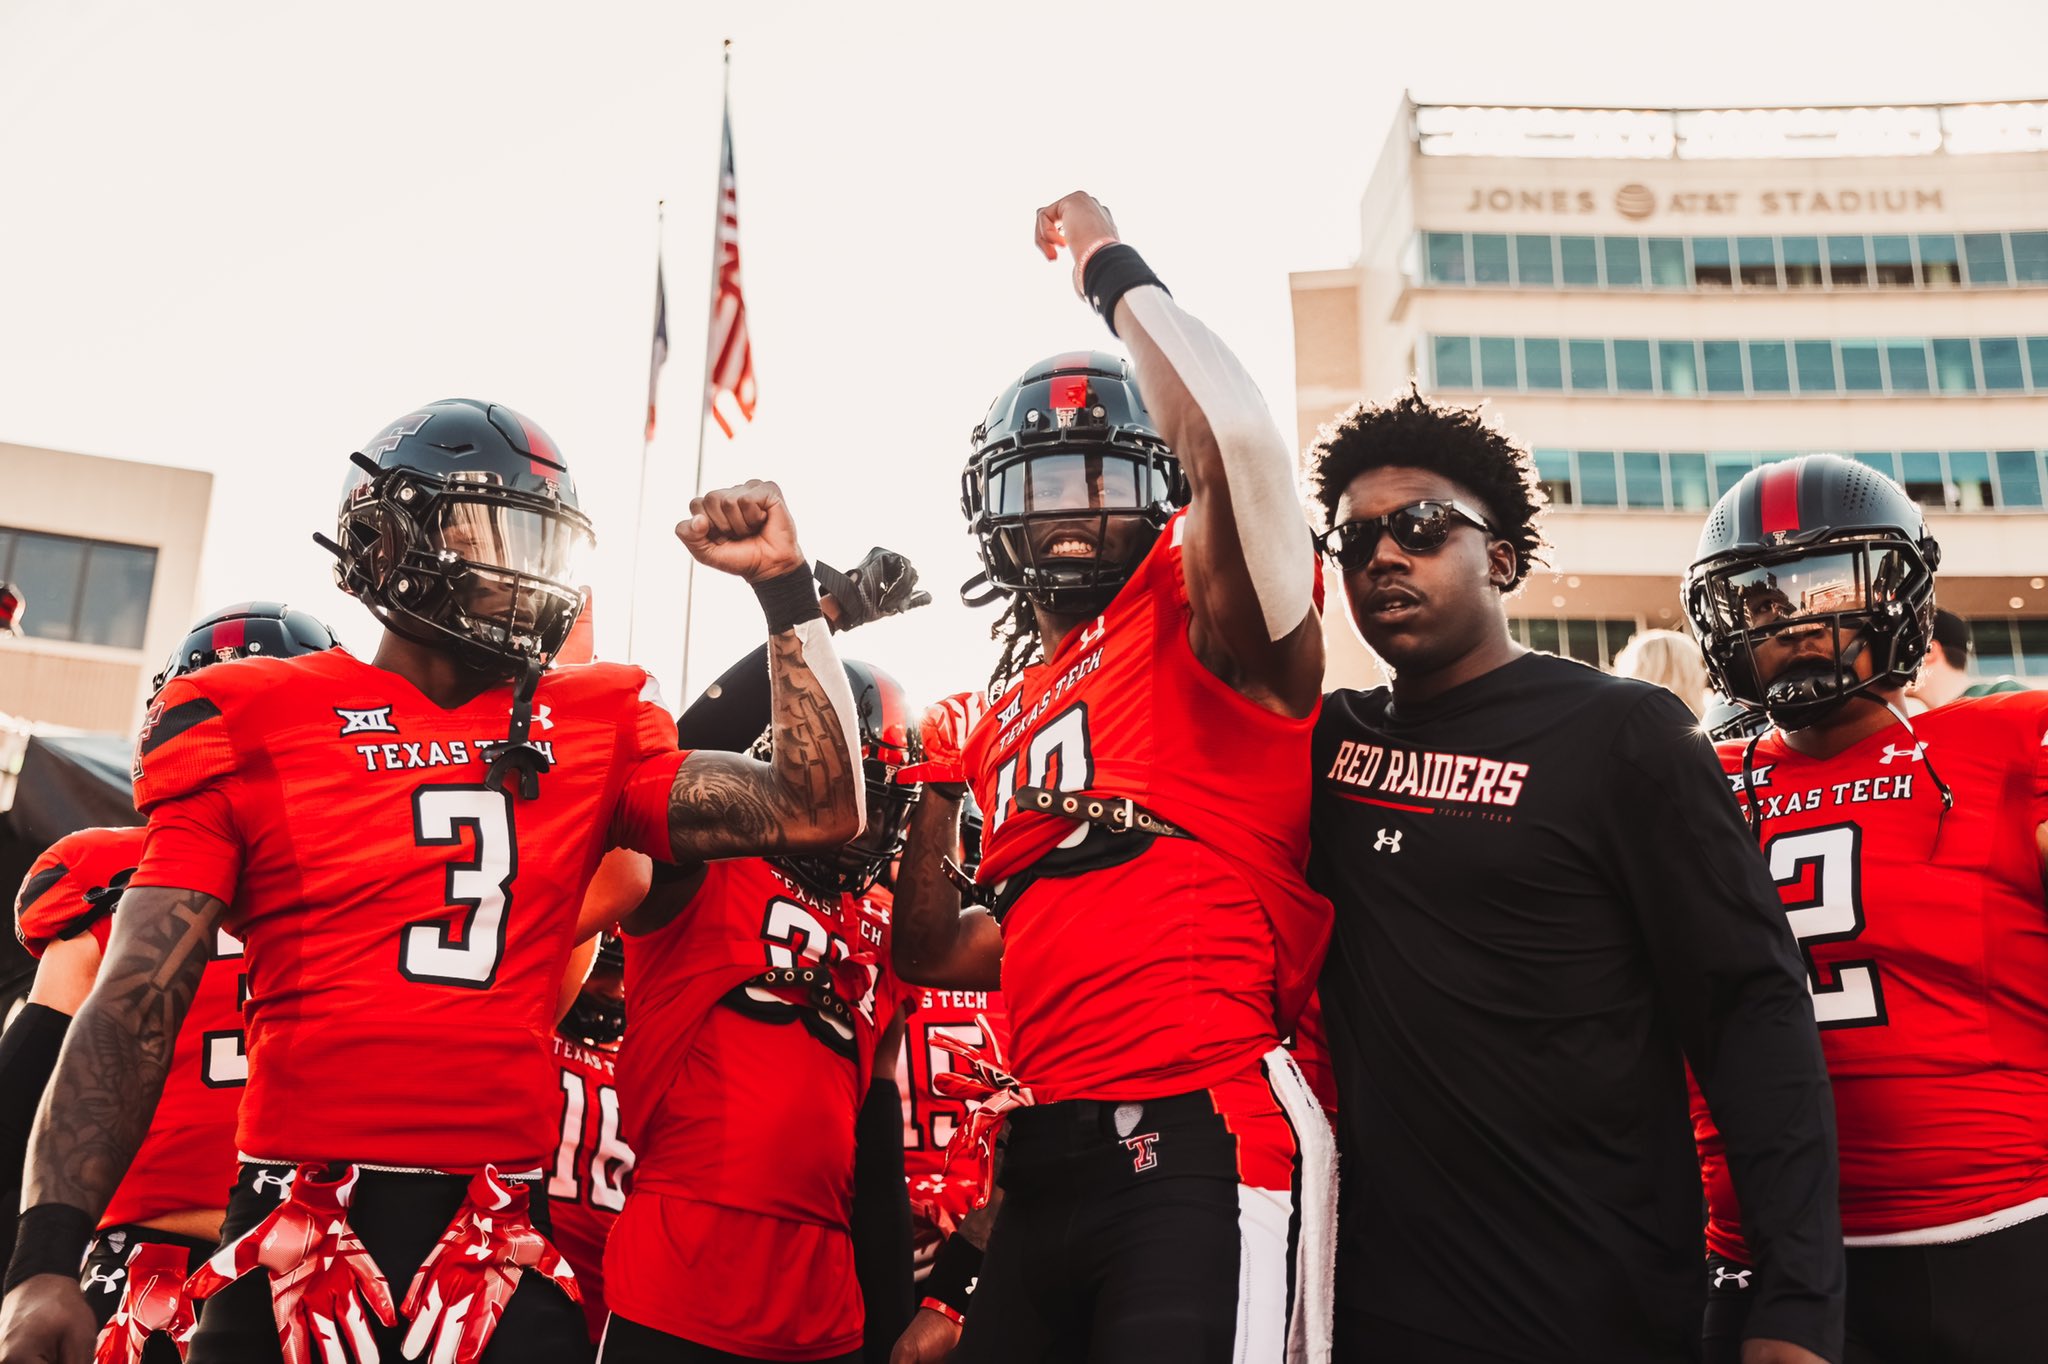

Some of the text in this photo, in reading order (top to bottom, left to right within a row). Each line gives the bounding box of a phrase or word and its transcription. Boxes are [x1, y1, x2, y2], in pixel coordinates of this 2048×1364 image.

[1466, 188, 1945, 216] JONES AT&T STADIUM
[998, 646, 1104, 754] TEXAS TECH
[355, 740, 470, 772] TEXAS
[1327, 740, 1530, 806] RED RAIDERS
[1830, 773, 1913, 806] TECH
[398, 783, 519, 990] 3
[1764, 820, 1889, 1031] 2
[936, 990, 988, 1010] TECH
[553, 1036, 603, 1071] TEXAS
[545, 1066, 637, 1215] 16
